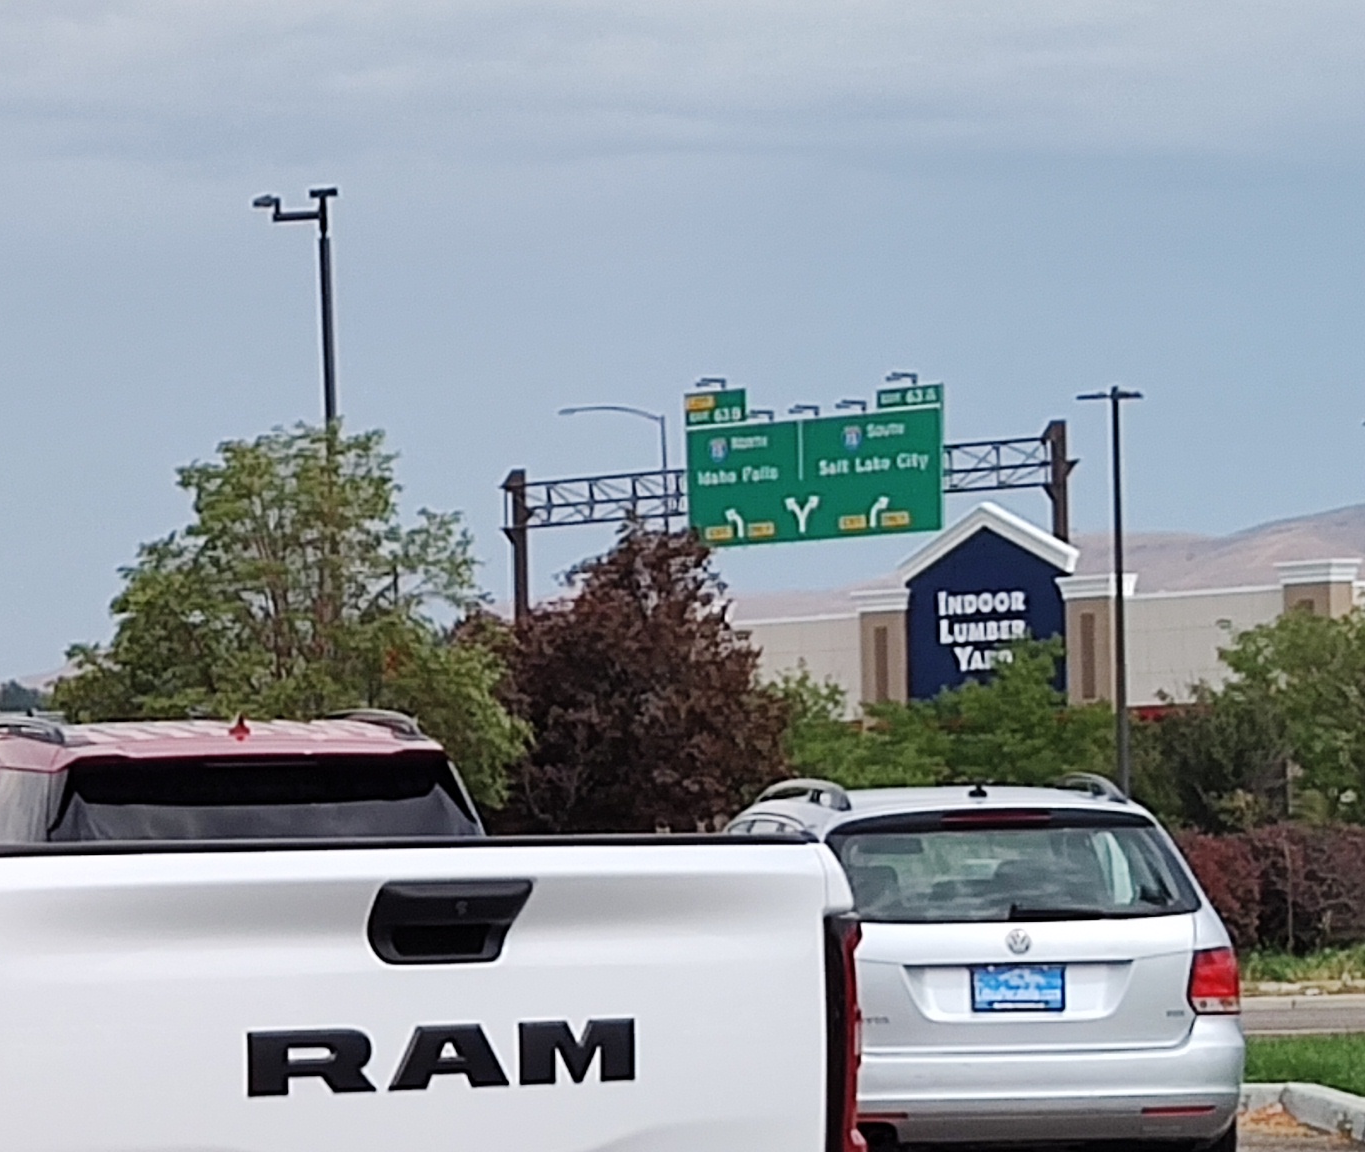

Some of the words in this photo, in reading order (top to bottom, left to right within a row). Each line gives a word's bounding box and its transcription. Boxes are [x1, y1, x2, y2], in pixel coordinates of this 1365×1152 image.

[697, 470, 737, 486] Idaho
[742, 466, 779, 482] Falls
[819, 459, 849, 476] Salt
[855, 456, 891, 473] Lake
[897, 453, 929, 470] City
[937, 590, 1027, 616] INDOOR
[247, 1018, 636, 1097] RAM
